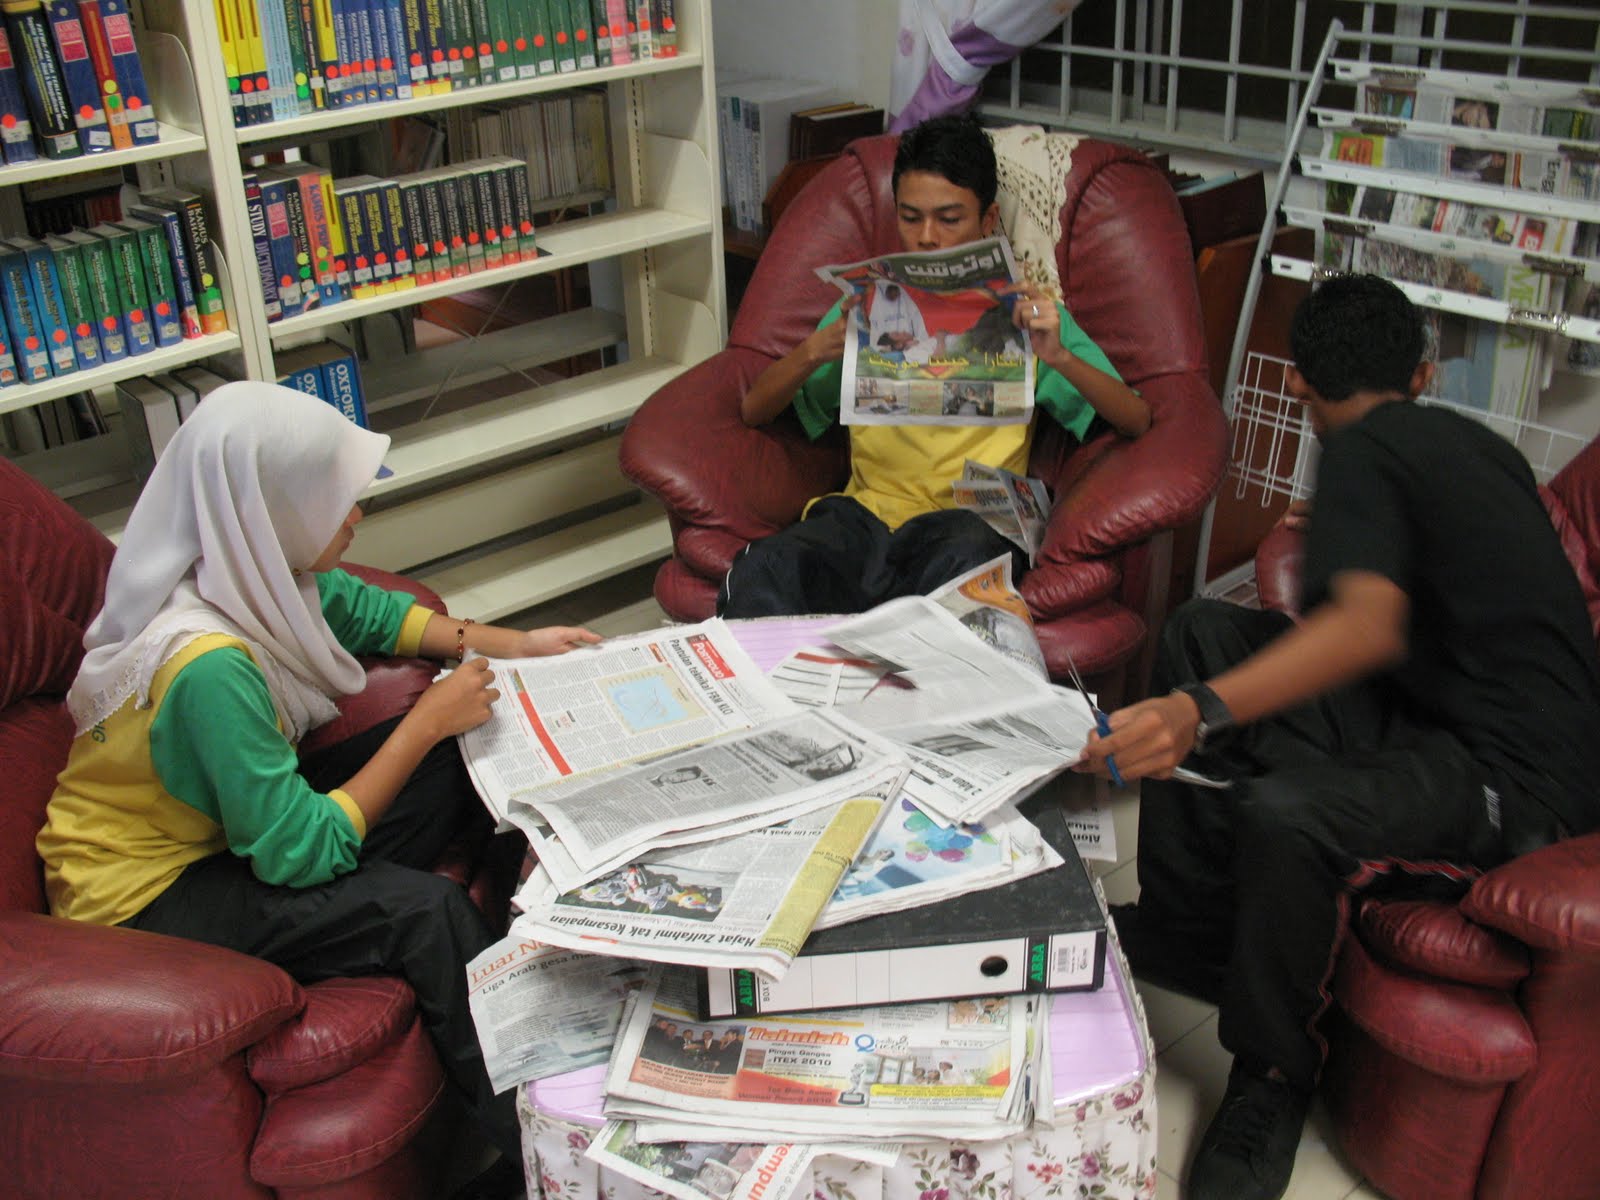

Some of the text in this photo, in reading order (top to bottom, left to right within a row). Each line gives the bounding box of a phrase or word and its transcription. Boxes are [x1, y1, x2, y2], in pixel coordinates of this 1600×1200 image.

[337, 13, 346, 38] KAMUS
[349, 12, 359, 35] KAMUS
[361, 10, 370, 34] KAMUS
[377, 9, 387, 33] KAMUS
[393, 6, 403, 32] KAMUS
[292, 192, 303, 220] KAMUS
[309, 184, 325, 222] KAMUS
[172, 220, 184, 256] LONGMAN
[187, 209, 202, 250] BAHASA
[195, 207, 209, 244] KAMUS
[248, 204, 278, 301] STUDY DICTIONARY
[669, 638, 693, 667] Pantulan
[688, 665, 713, 692] teknikal
[707, 690, 724, 705] FBM
[549, 915, 626, 936] kesampaian
[630, 926, 652, 937] tak
[654, 929, 716, 944] Zulfahmi
[718, 933, 756, 947] Hajat
[471, 950, 516, 984] Luar
[481, 956, 568, 995] Liga Arab gesa
[1030, 943, 1045, 983] ABBA
[739, 969, 752, 1007] ABBA
[768, 1048, 798, 1056] Pingat
[773, 1056, 831, 1066] ITEX 2010
